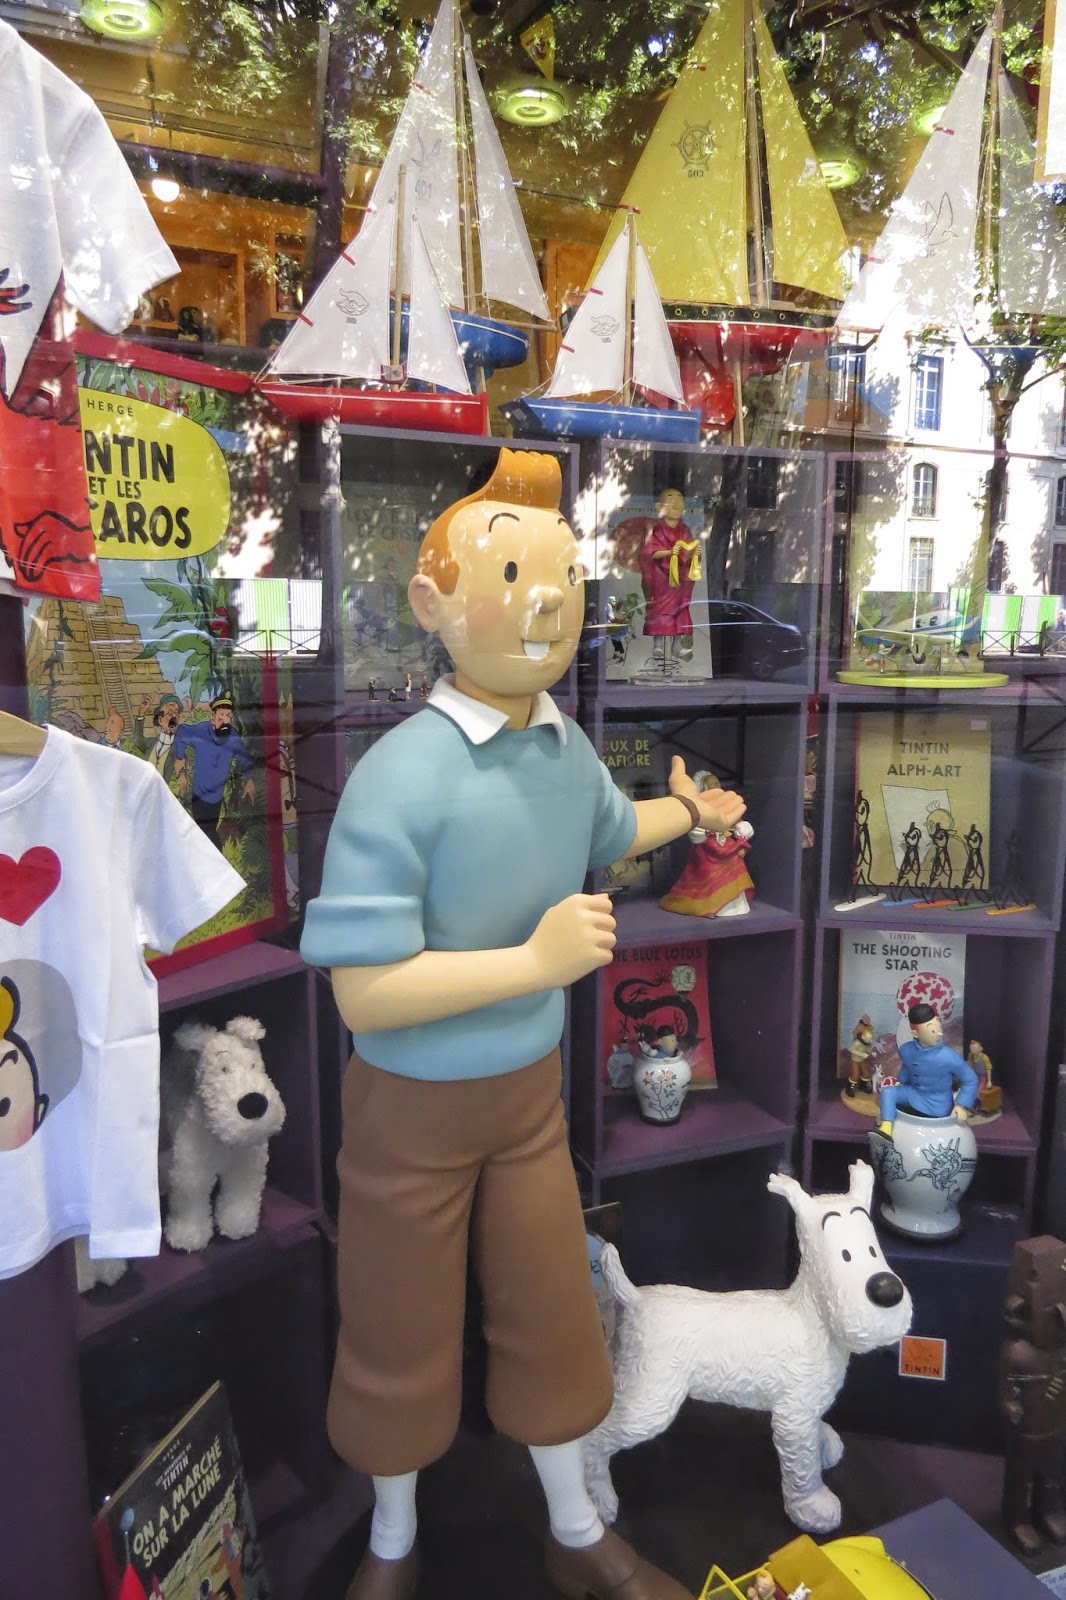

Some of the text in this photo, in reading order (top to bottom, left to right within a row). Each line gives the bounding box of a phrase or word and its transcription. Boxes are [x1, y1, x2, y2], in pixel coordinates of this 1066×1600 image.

[87, 398, 134, 417] HERGÉ
[84, 429, 175, 484] NTIN
[89, 476, 142, 500] ET LES
[86, 497, 192, 549] AROS
[635, 739, 650, 752] DE
[900, 741, 949, 755] TINTIN
[887, 763, 962, 778] ALPH-ART
[612, 948, 627, 961] HE
[853, 943, 952, 959] THE SHOOTING
[885, 958, 918, 972] STAR
[904, 1364, 940, 1376] TINTIN
[161, 1454, 189, 1491] TINTIN
[133, 1520, 155, 1555] ON
[159, 1504, 170, 1528] A
[172, 1435, 223, 1511] MARCHÉ
[143, 1526, 170, 1568] SUR
[172, 1504, 191, 1534] LA
[191, 1461, 222, 1510] LUNE
